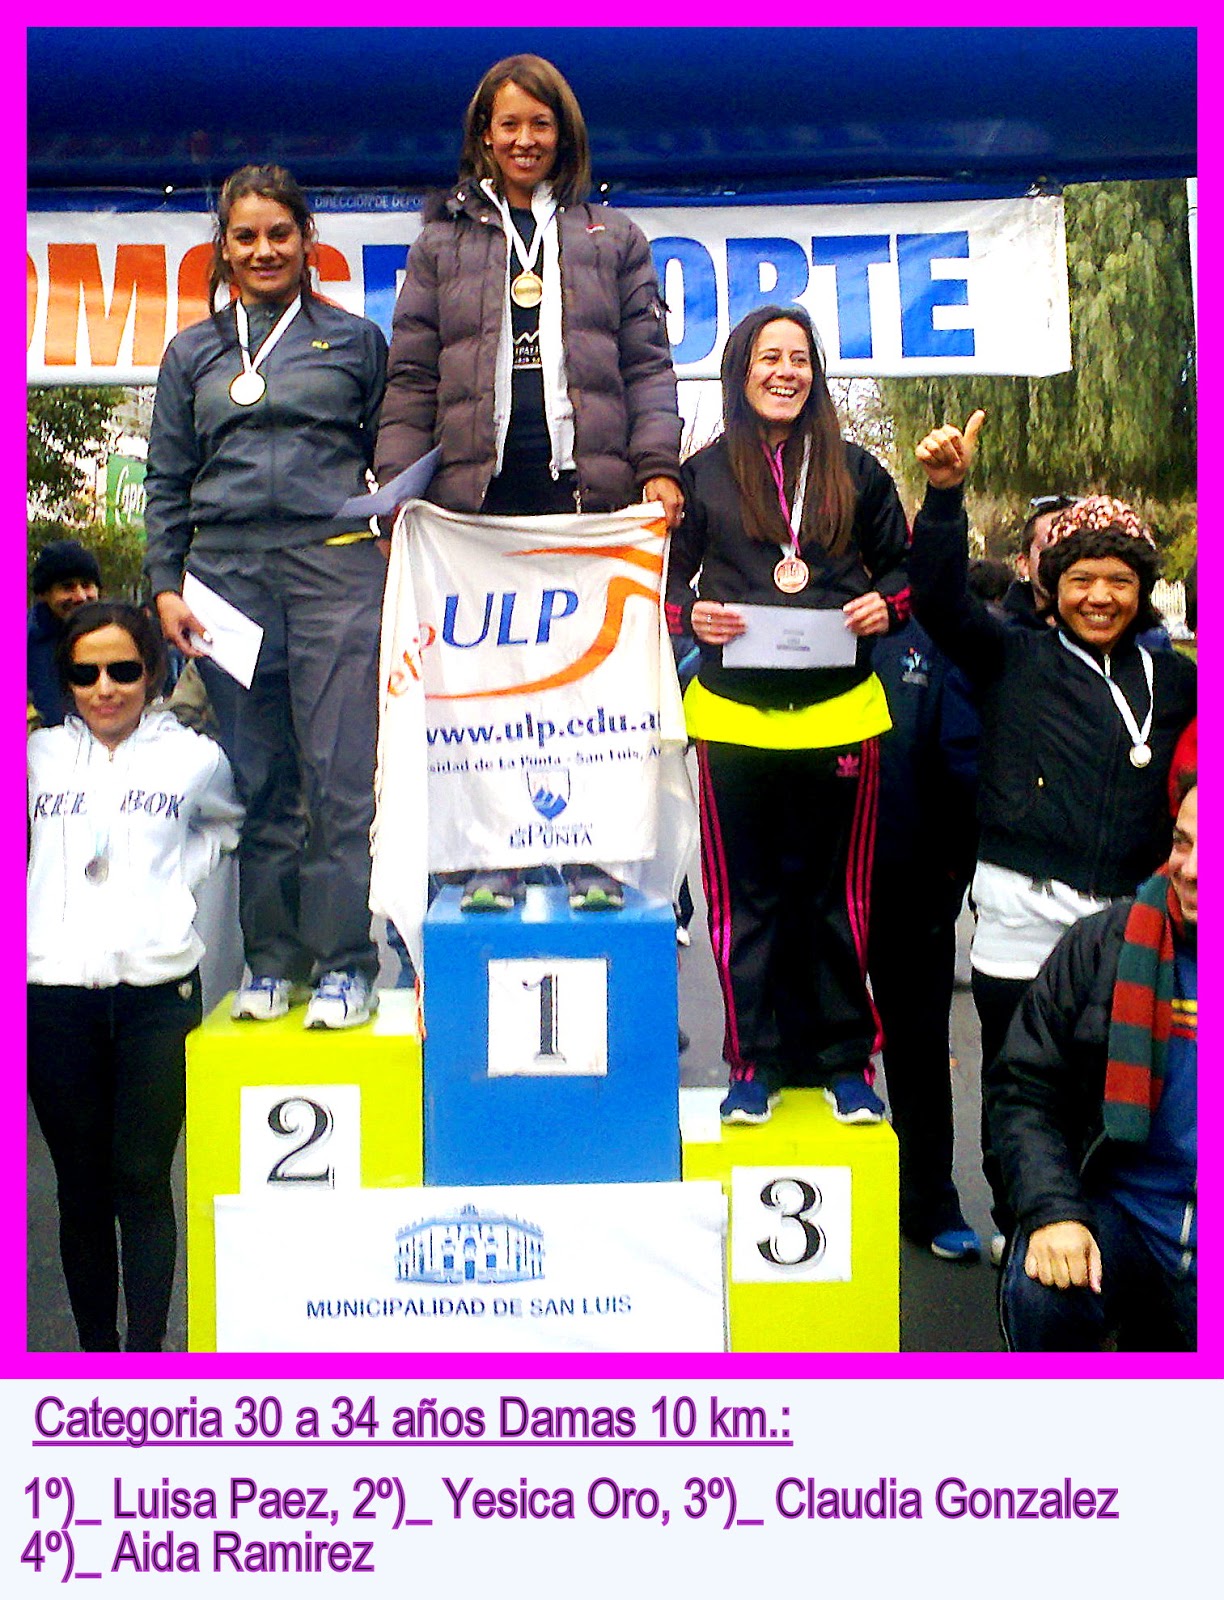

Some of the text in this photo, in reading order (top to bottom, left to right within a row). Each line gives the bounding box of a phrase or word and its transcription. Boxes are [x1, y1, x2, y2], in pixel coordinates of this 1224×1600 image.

[442, 588, 579, 648] ULP
[521, 972, 567, 1064] 1
[266, 1095, 335, 1190] 2
[756, 1176, 827, 1274] 3
[306, 1294, 632, 1319] MUNICIPALIDAD DE SAN LUIS
